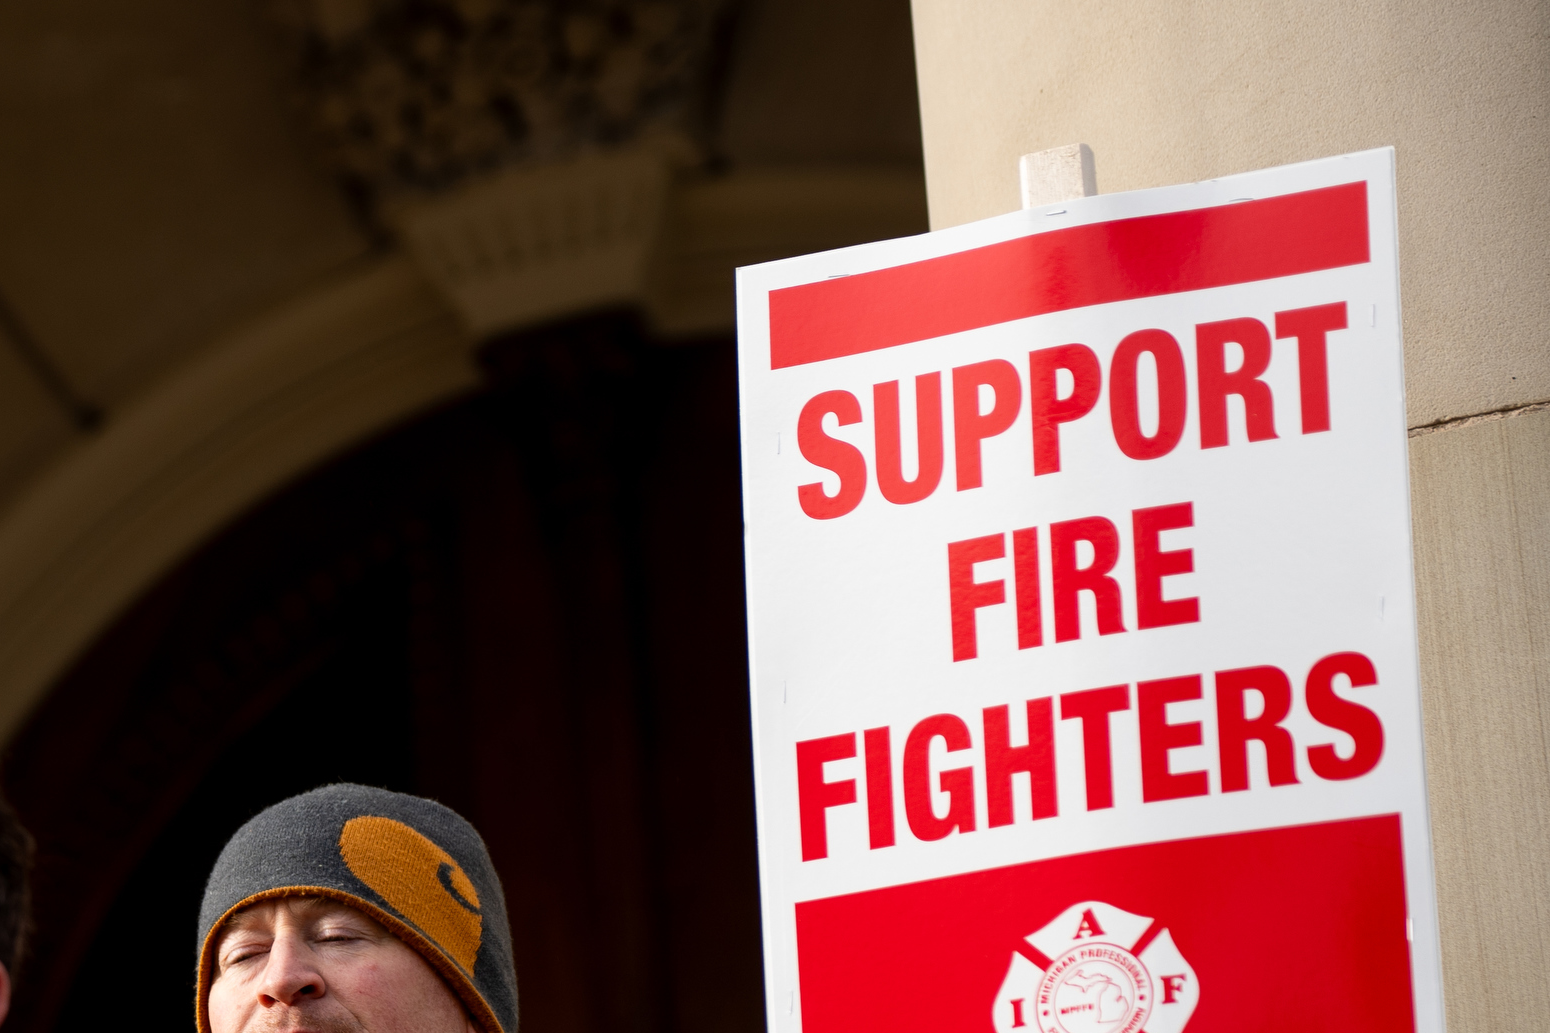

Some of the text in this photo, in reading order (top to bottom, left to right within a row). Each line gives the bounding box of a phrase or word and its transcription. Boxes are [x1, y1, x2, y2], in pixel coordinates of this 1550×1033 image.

[797, 301, 1347, 520] SUPPORT
[948, 502, 1200, 662] FIRE
[796, 651, 1385, 862] FIGHTERS
[1073, 908, 1106, 940] A
[1040, 948, 1146, 1004] MICHIGAN PROFESSIONAL
[1161, 974, 1186, 1004] F
[1010, 998, 1026, 1028] I
